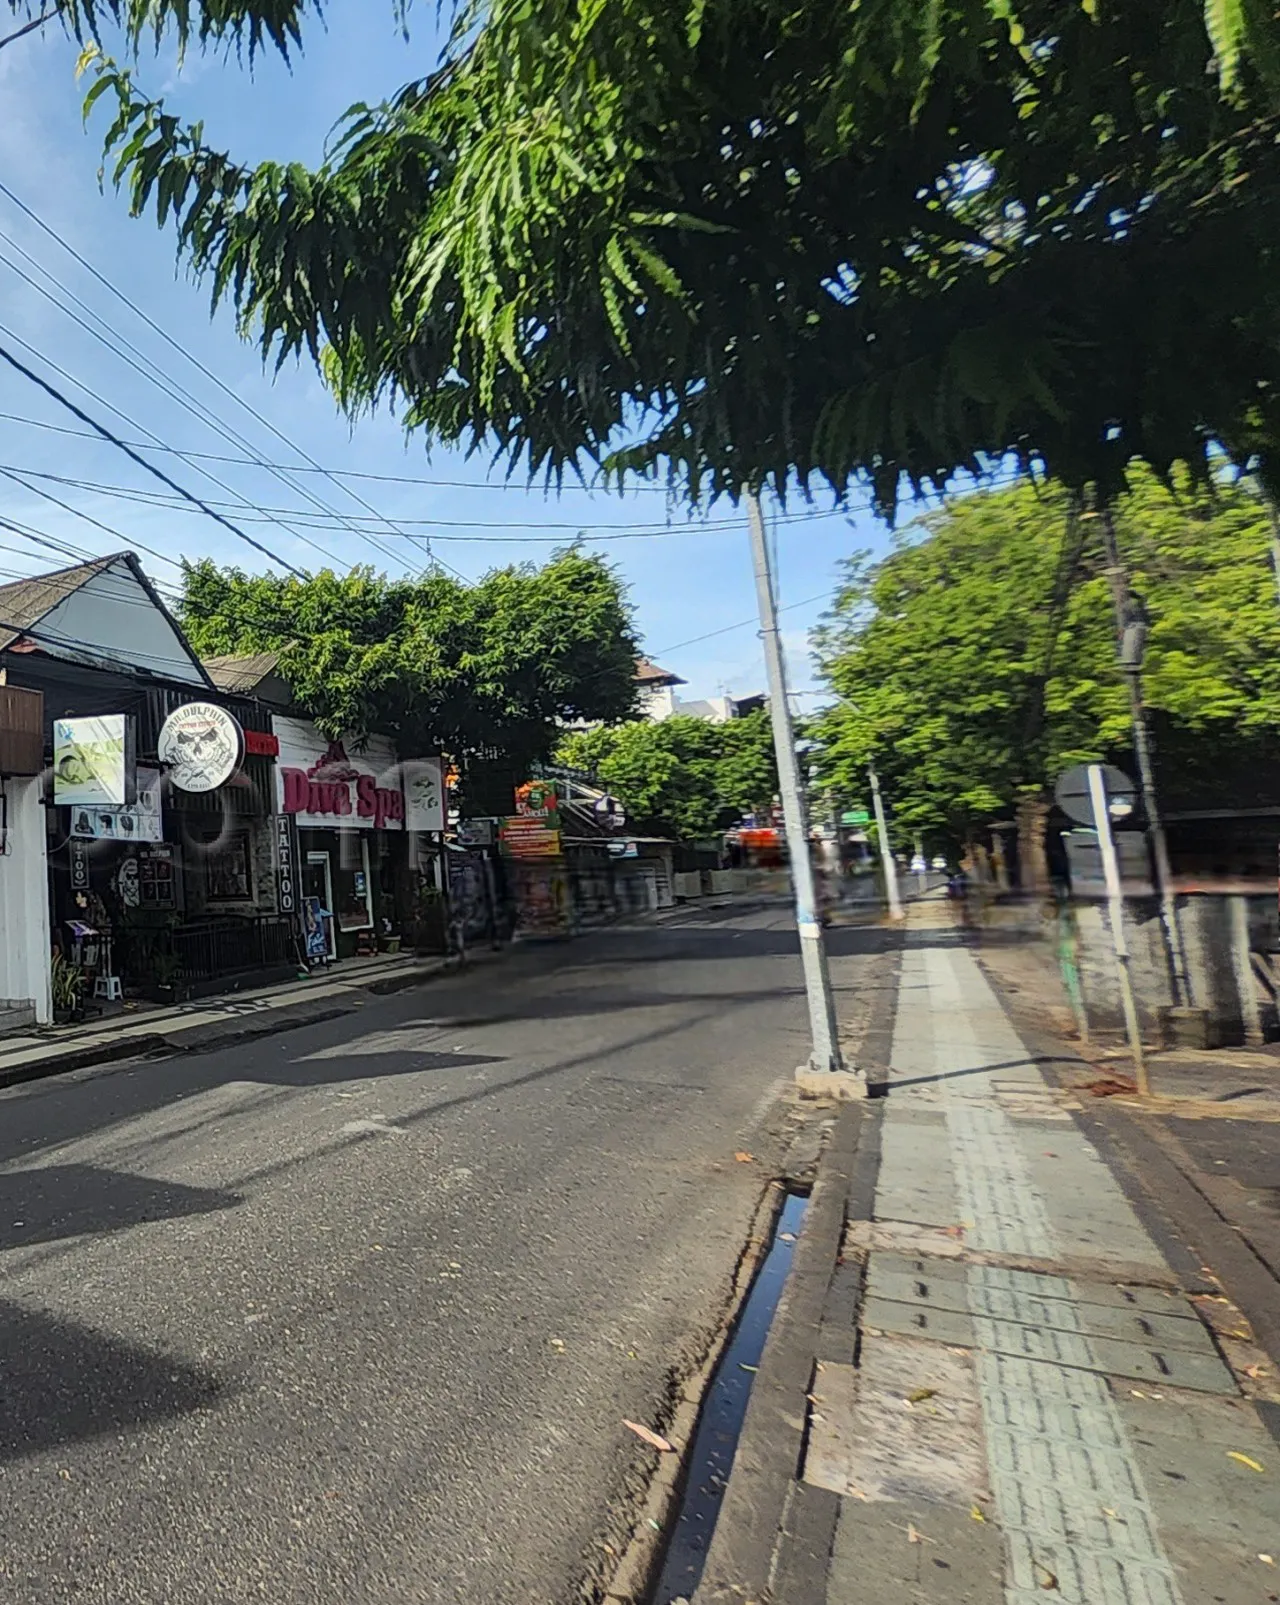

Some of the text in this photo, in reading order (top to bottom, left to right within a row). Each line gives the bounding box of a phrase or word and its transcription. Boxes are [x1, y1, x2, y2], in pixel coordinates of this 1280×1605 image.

[282, 766, 405, 828] Diva Spa
[278, 818, 292, 908] TATTOO
